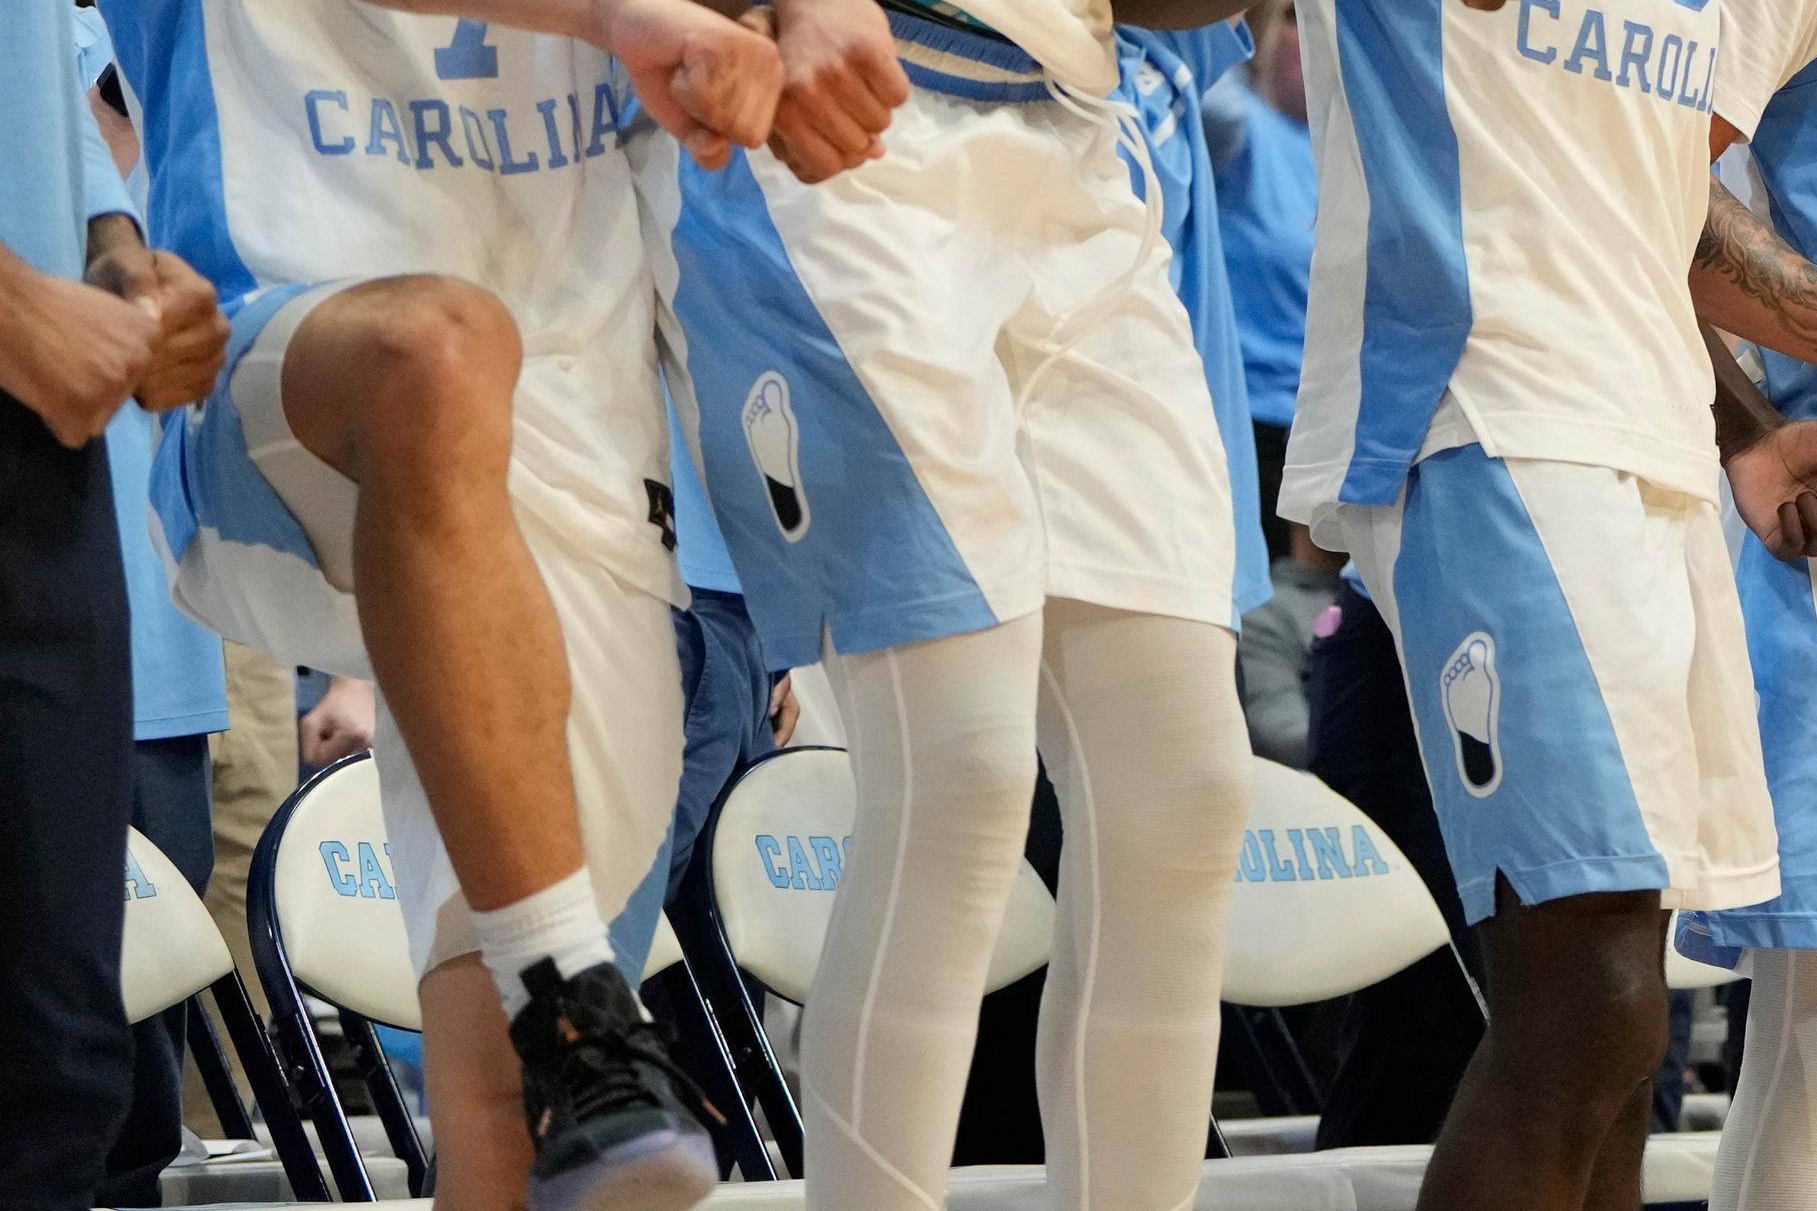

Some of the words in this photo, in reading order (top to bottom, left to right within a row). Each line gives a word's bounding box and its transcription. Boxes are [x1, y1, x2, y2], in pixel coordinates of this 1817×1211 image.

[304, 83, 620, 176] CAROLIA
[755, 834, 853, 891] CAR
[1234, 825, 1390, 883] OLINA
